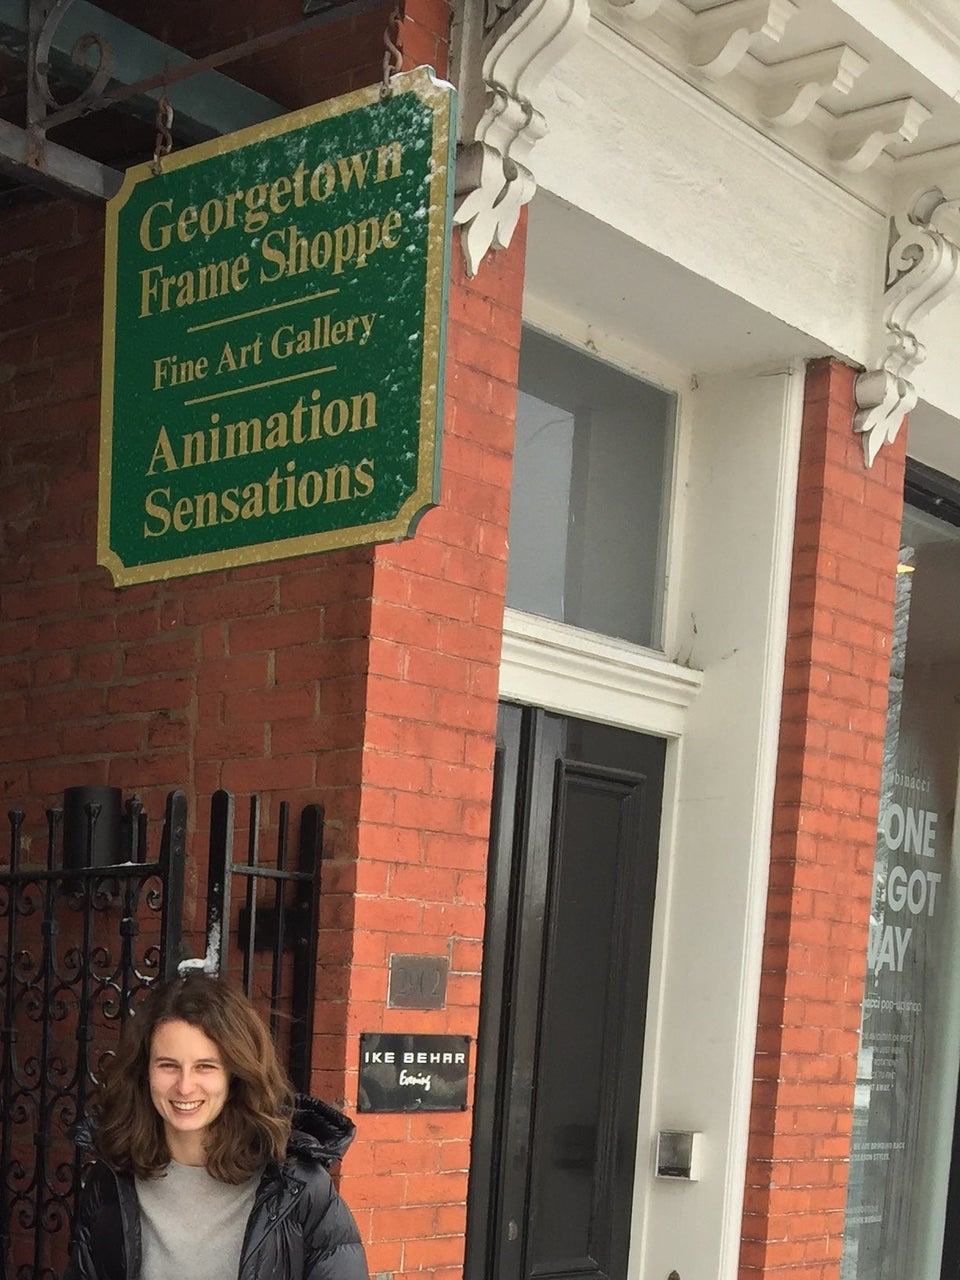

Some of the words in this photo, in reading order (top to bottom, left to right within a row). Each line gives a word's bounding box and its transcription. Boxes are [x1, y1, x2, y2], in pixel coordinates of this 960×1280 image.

[140, 141, 402, 251] Georgetown
[138, 254, 250, 318] Frame
[260, 209, 402, 284] Shoppe
[152, 355, 208, 391] Fine
[215, 337, 263, 375] Art
[271, 312, 377, 360] Gallery
[145, 389, 377, 476] Animation
[143, 459, 374, 538] Sensations
[883, 803, 938, 858] ONE
[888, 866, 942, 917] GOT
[365, 1052, 395, 1063] IKE
[403, 1052, 465, 1064] BEHAR
